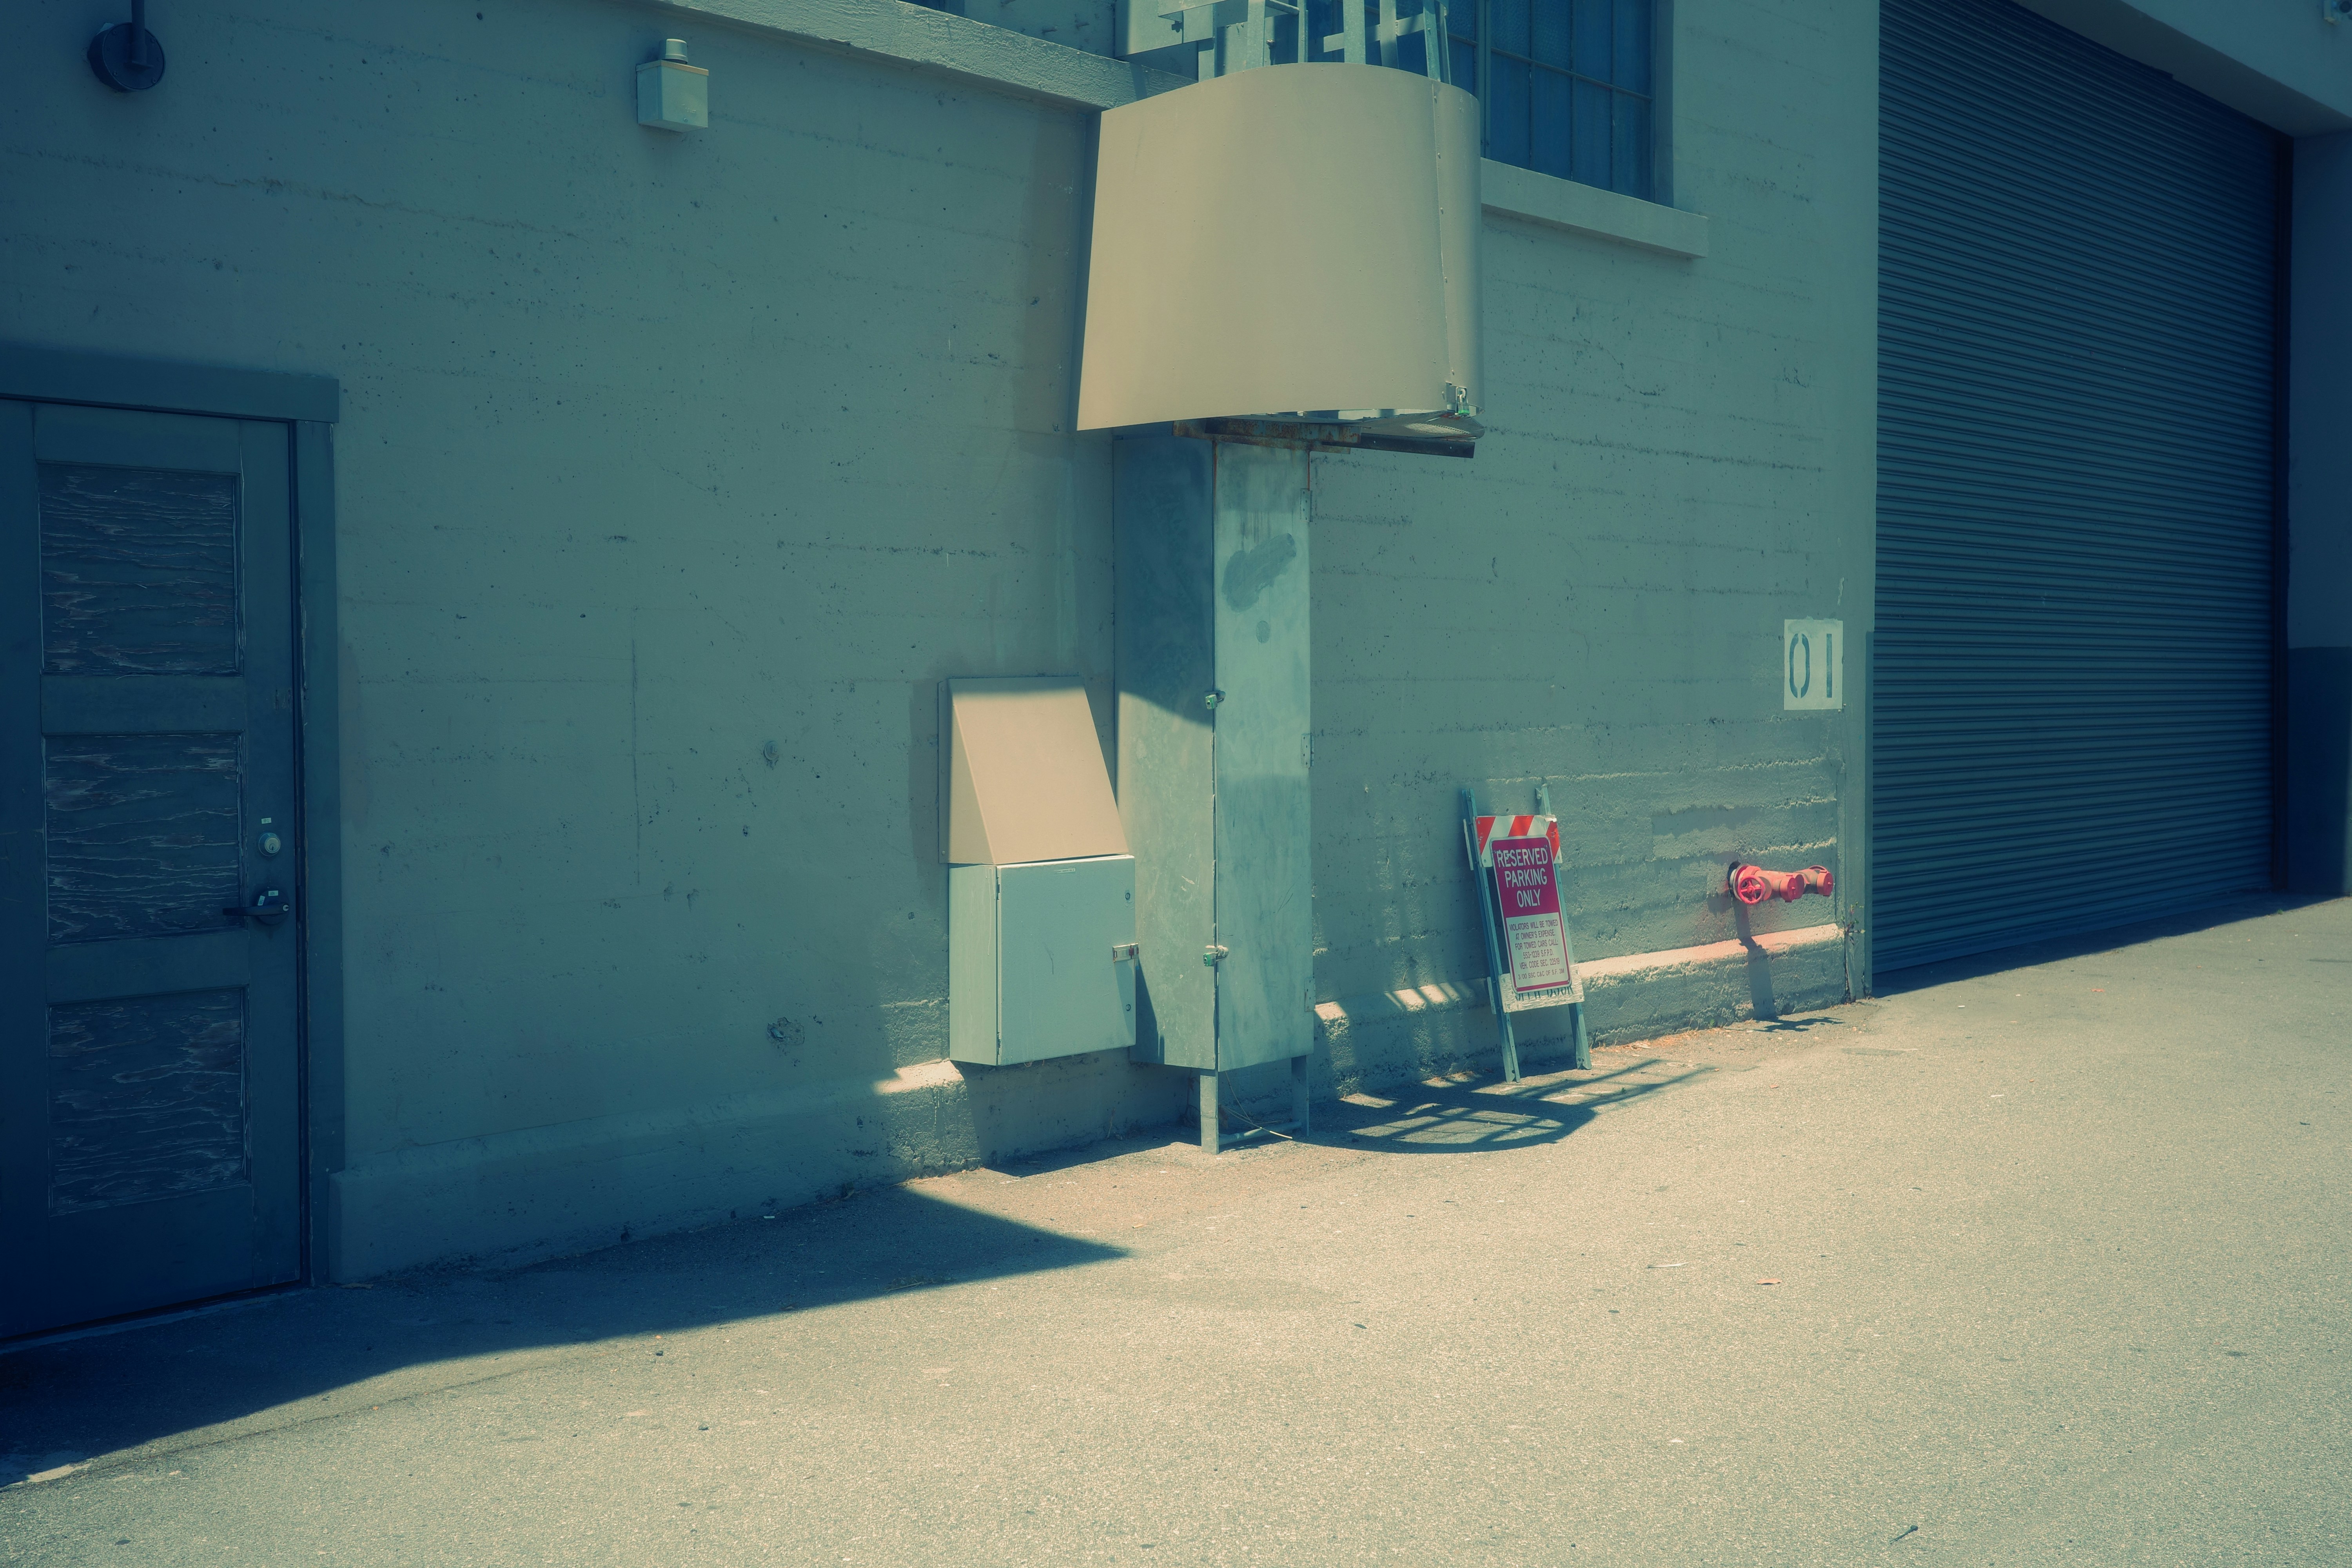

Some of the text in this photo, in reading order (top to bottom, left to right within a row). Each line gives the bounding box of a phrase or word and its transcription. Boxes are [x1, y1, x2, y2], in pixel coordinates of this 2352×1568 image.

[1789, 633, 1832, 699] 01
[1496, 848, 1548, 867] RESERVED
[1504, 868, 1547, 888] PARKING
[1517, 889, 1541, 908] ONLY
[1509, 922, 1529, 931] VIOLATORS
[1545, 919, 1558, 927] TOWED
[1521, 931, 1537, 940] OWNER'S
[1538, 929, 1555, 938] EXPENSE.
[1524, 941, 1537, 949] TOWED
[1537, 939, 1548, 947] CARS
[1523, 950, 1540, 959] 553-1239
[1529, 960, 1539, 968] CODE
